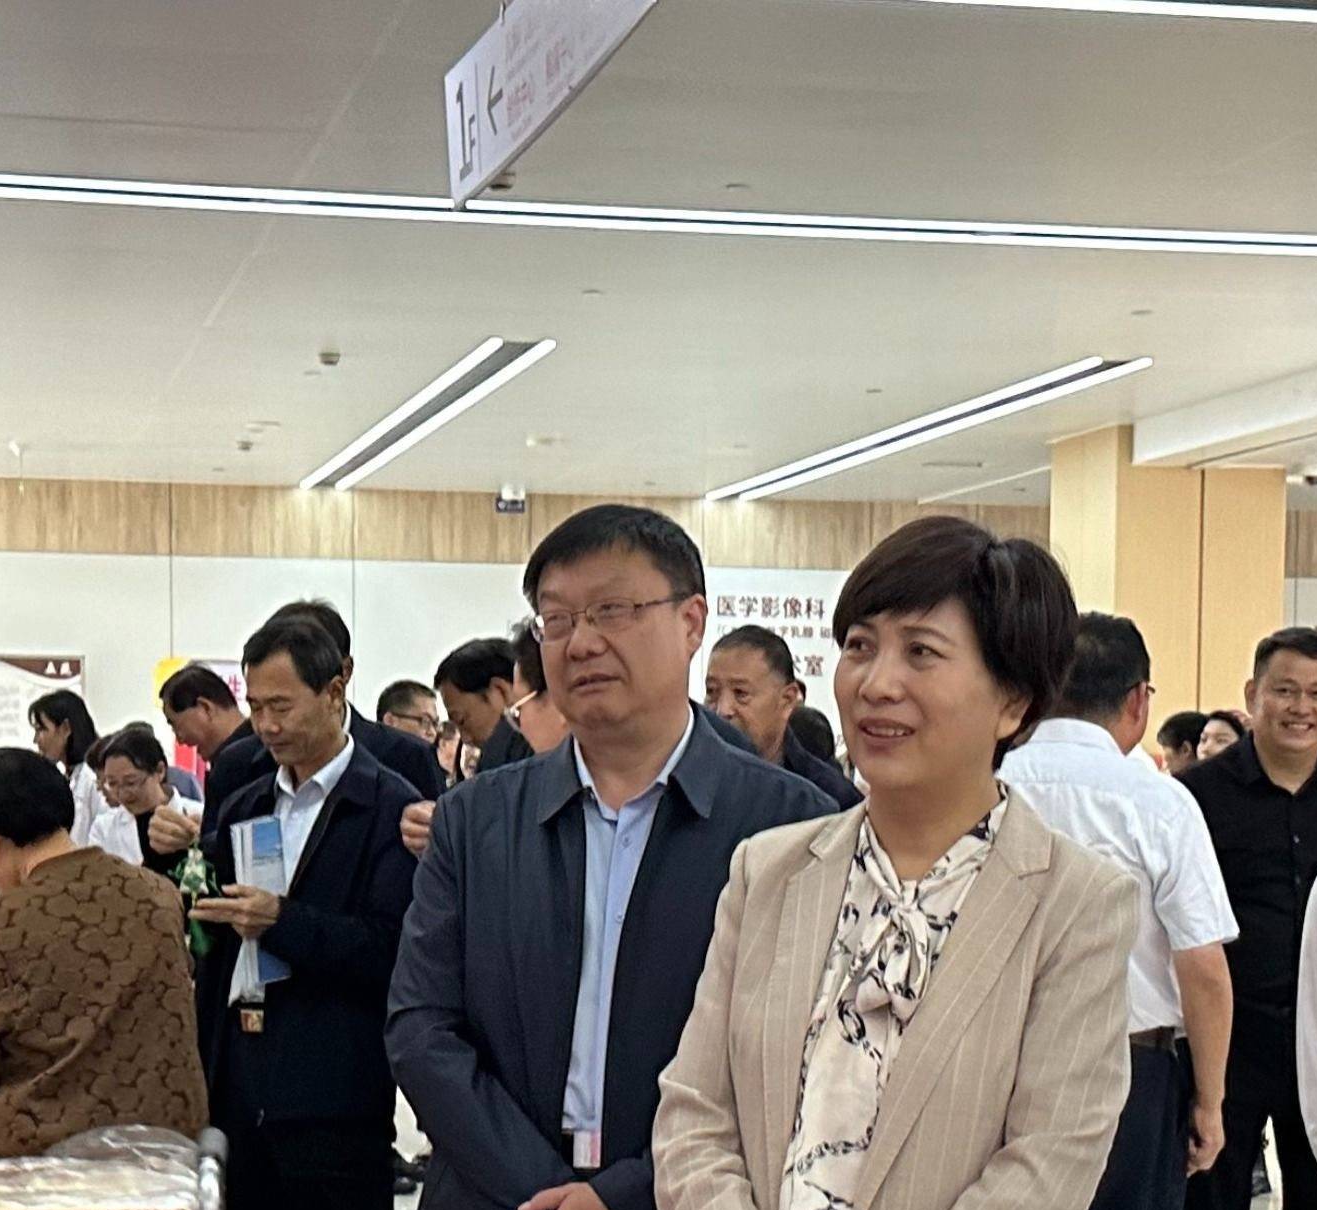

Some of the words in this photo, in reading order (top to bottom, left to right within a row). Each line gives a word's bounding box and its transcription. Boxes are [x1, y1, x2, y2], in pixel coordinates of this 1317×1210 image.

[455, 81, 476, 182] 1F
[716, 595, 825, 619] 医学影像科
